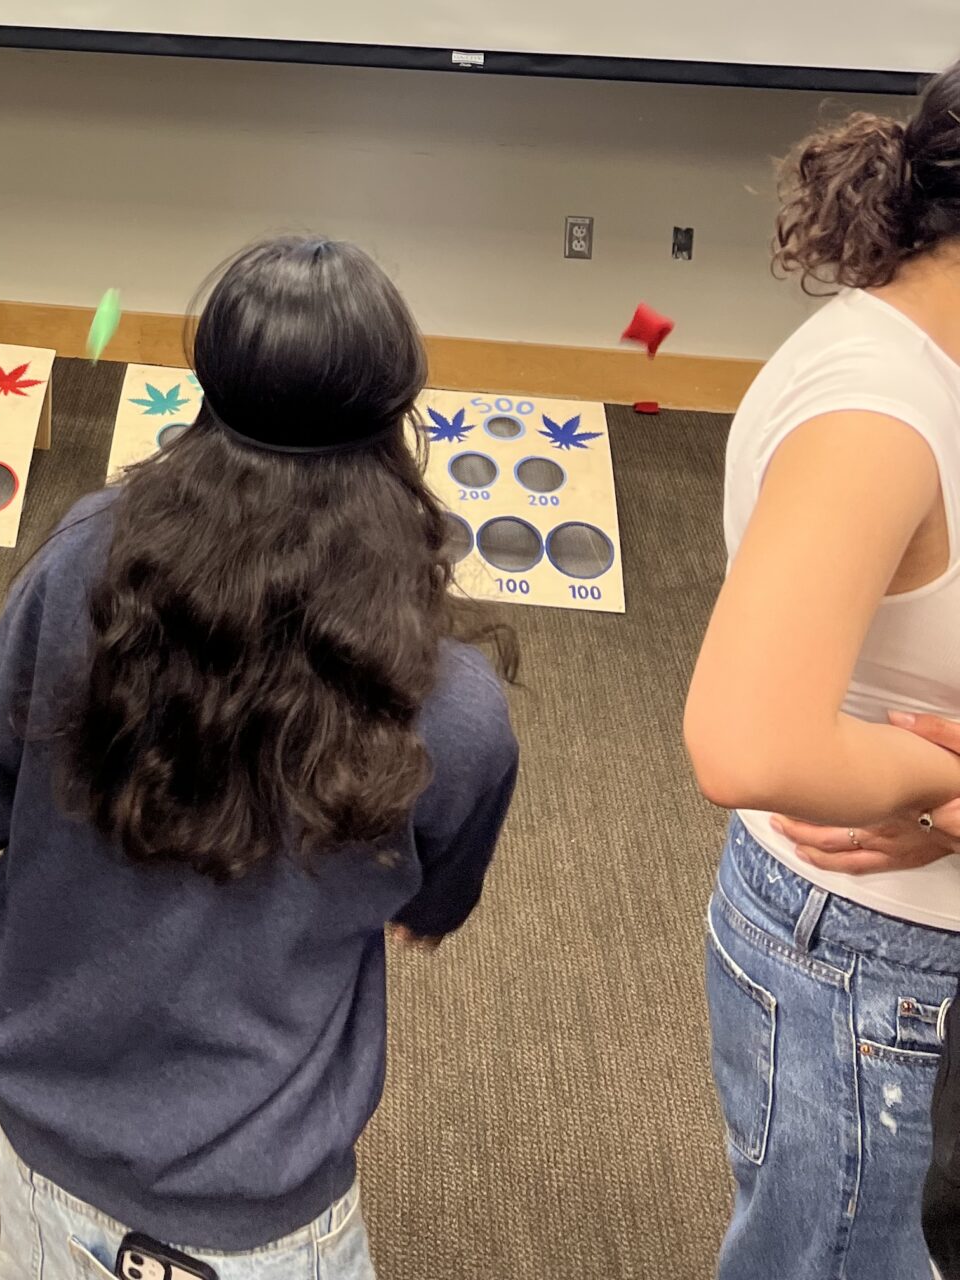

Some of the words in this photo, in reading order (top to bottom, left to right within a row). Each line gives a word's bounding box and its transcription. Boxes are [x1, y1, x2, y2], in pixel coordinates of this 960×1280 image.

[470, 397, 535, 416] 500
[458, 489, 491, 501] 200
[527, 494, 560, 507] 200
[494, 578, 530, 595] 100
[568, 584, 602, 601] 100
